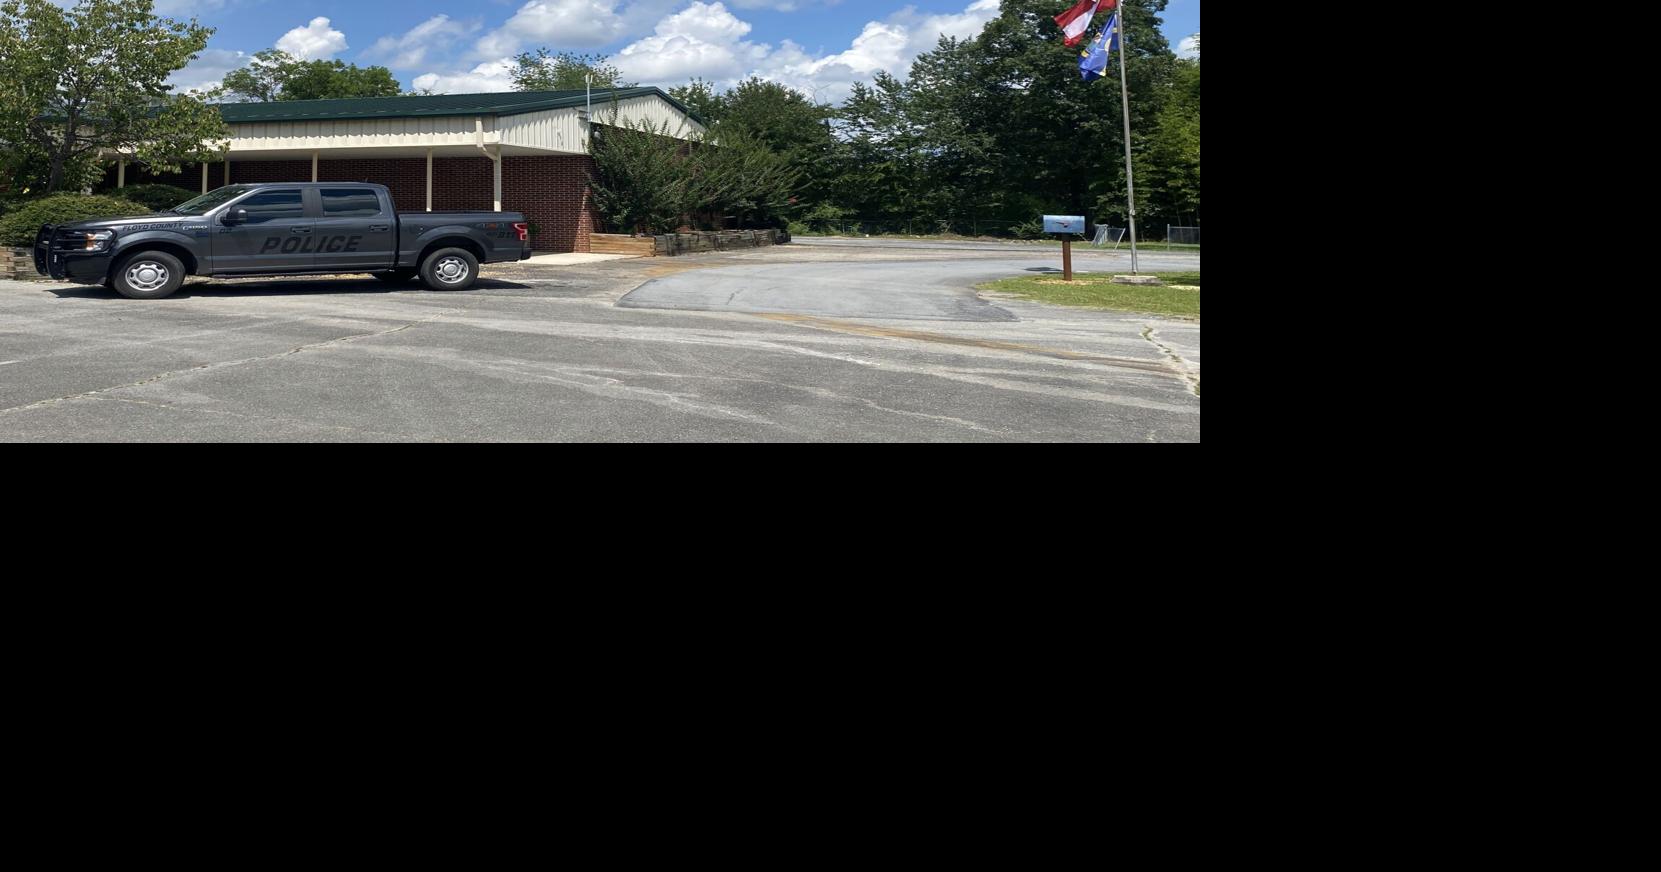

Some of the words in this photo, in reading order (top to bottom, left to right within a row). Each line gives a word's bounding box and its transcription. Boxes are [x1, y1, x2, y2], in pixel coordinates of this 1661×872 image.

[122, 224, 149, 232] FLOYD
[149, 222, 183, 230] COUNTY
[260, 236, 362, 254] POLICE
